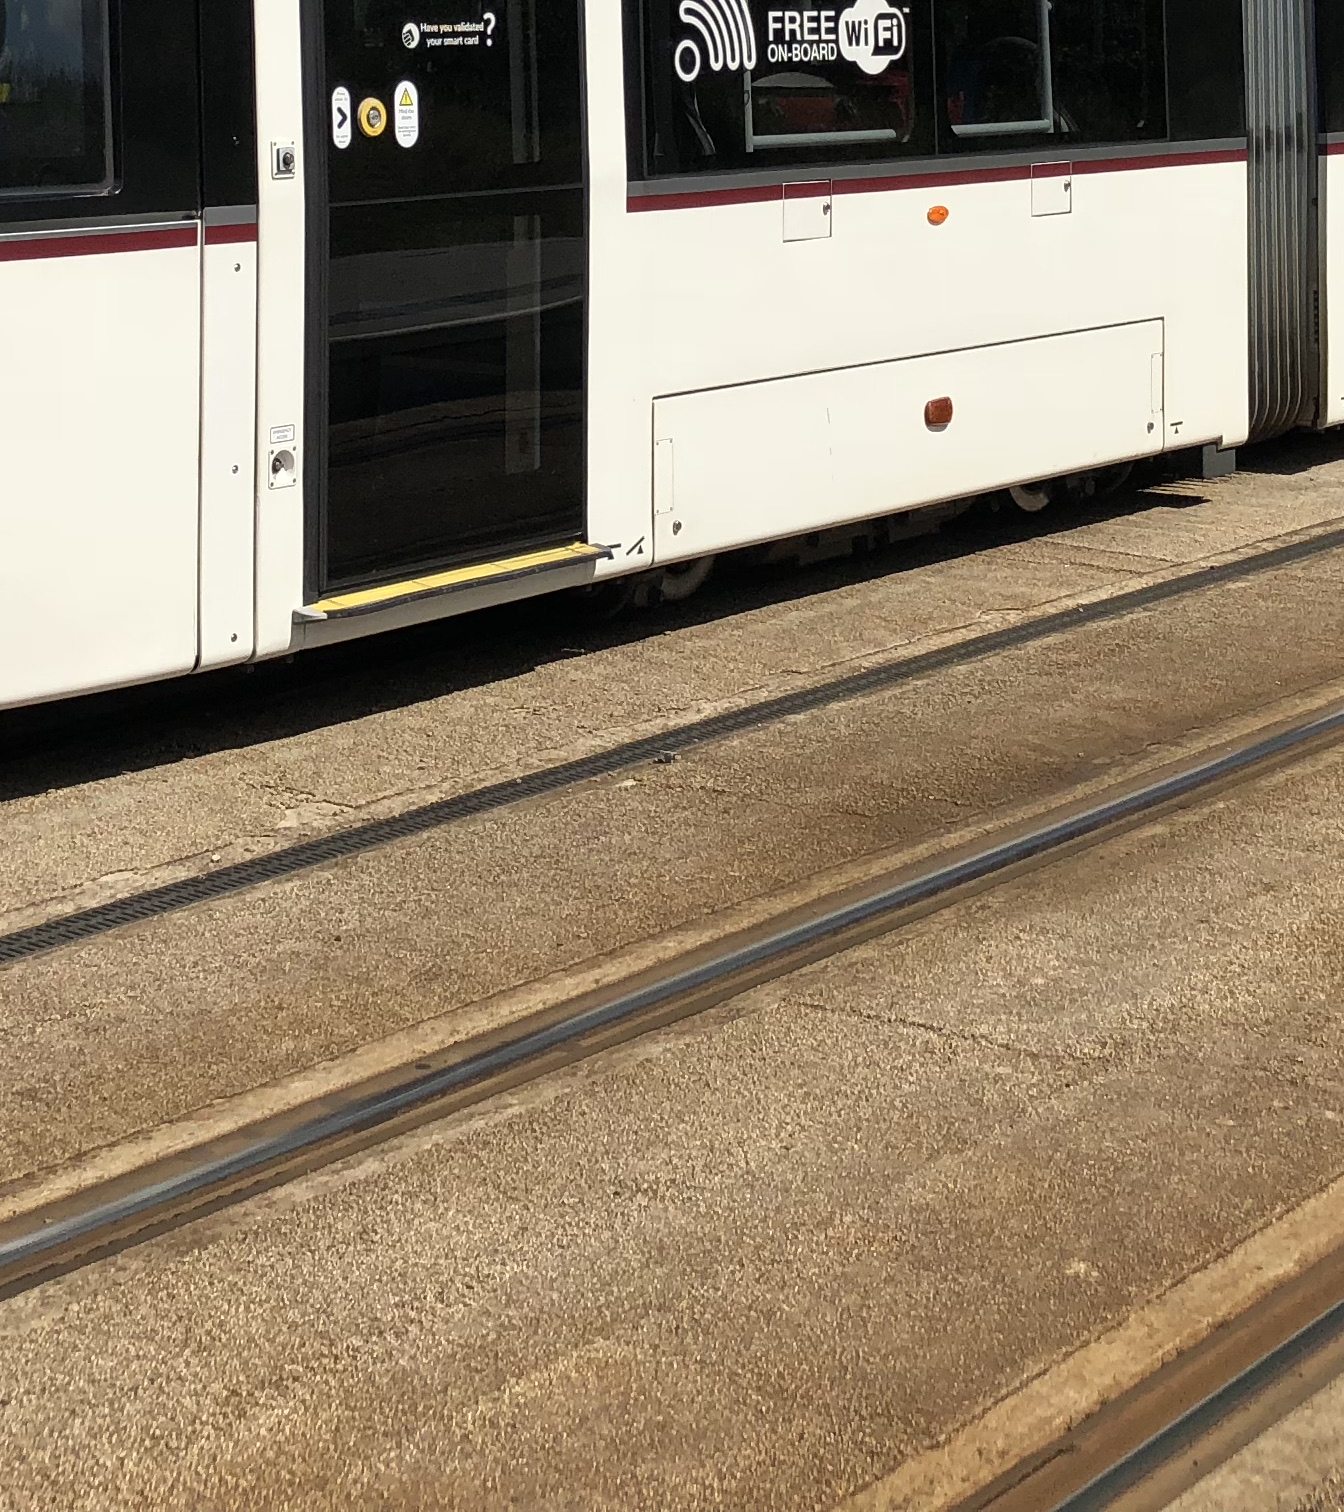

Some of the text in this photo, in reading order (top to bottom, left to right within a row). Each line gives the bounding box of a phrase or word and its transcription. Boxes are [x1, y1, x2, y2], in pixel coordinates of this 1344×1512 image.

[420, 21, 484, 34] Have you validated
[767, 11, 837, 41] FREE
[426, 37, 442, 48] your
[443, 35, 463, 45] smart
[767, 43, 838, 63] ON-BOARD
